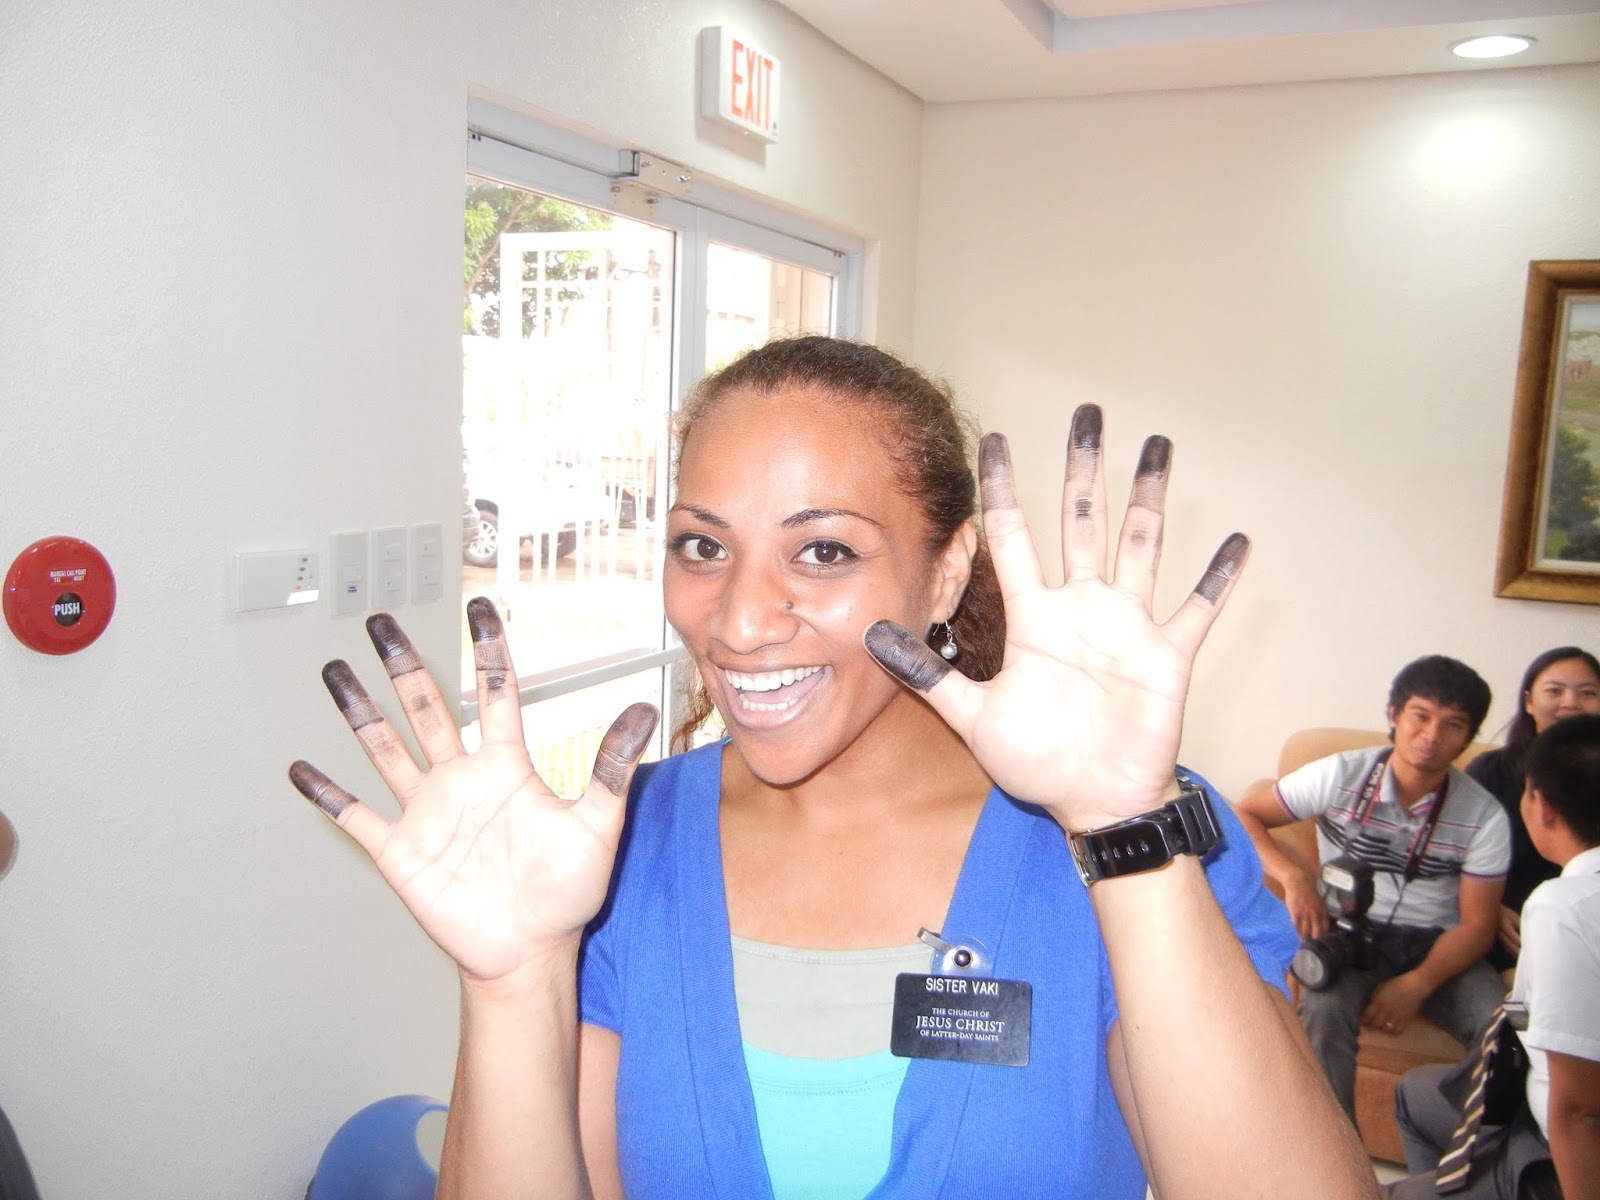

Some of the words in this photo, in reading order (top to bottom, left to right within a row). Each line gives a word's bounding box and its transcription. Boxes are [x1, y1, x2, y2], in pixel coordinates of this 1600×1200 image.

[731, 38, 774, 132] EXIT
[54, 602, 80, 616] PUSH
[925, 977, 967, 993] SISTER
[971, 980, 999, 996] VAKI
[932, 1007, 946, 1015] THE
[947, 1008, 978, 1017] CHURCH
[979, 1010, 990, 1018] OF
[915, 1015, 952, 1029] JESUS
[955, 1018, 1005, 1033] CHRIST
[931, 1030, 973, 1040] LATTER-DAY
[974, 1033, 999, 1042] SAINTS
